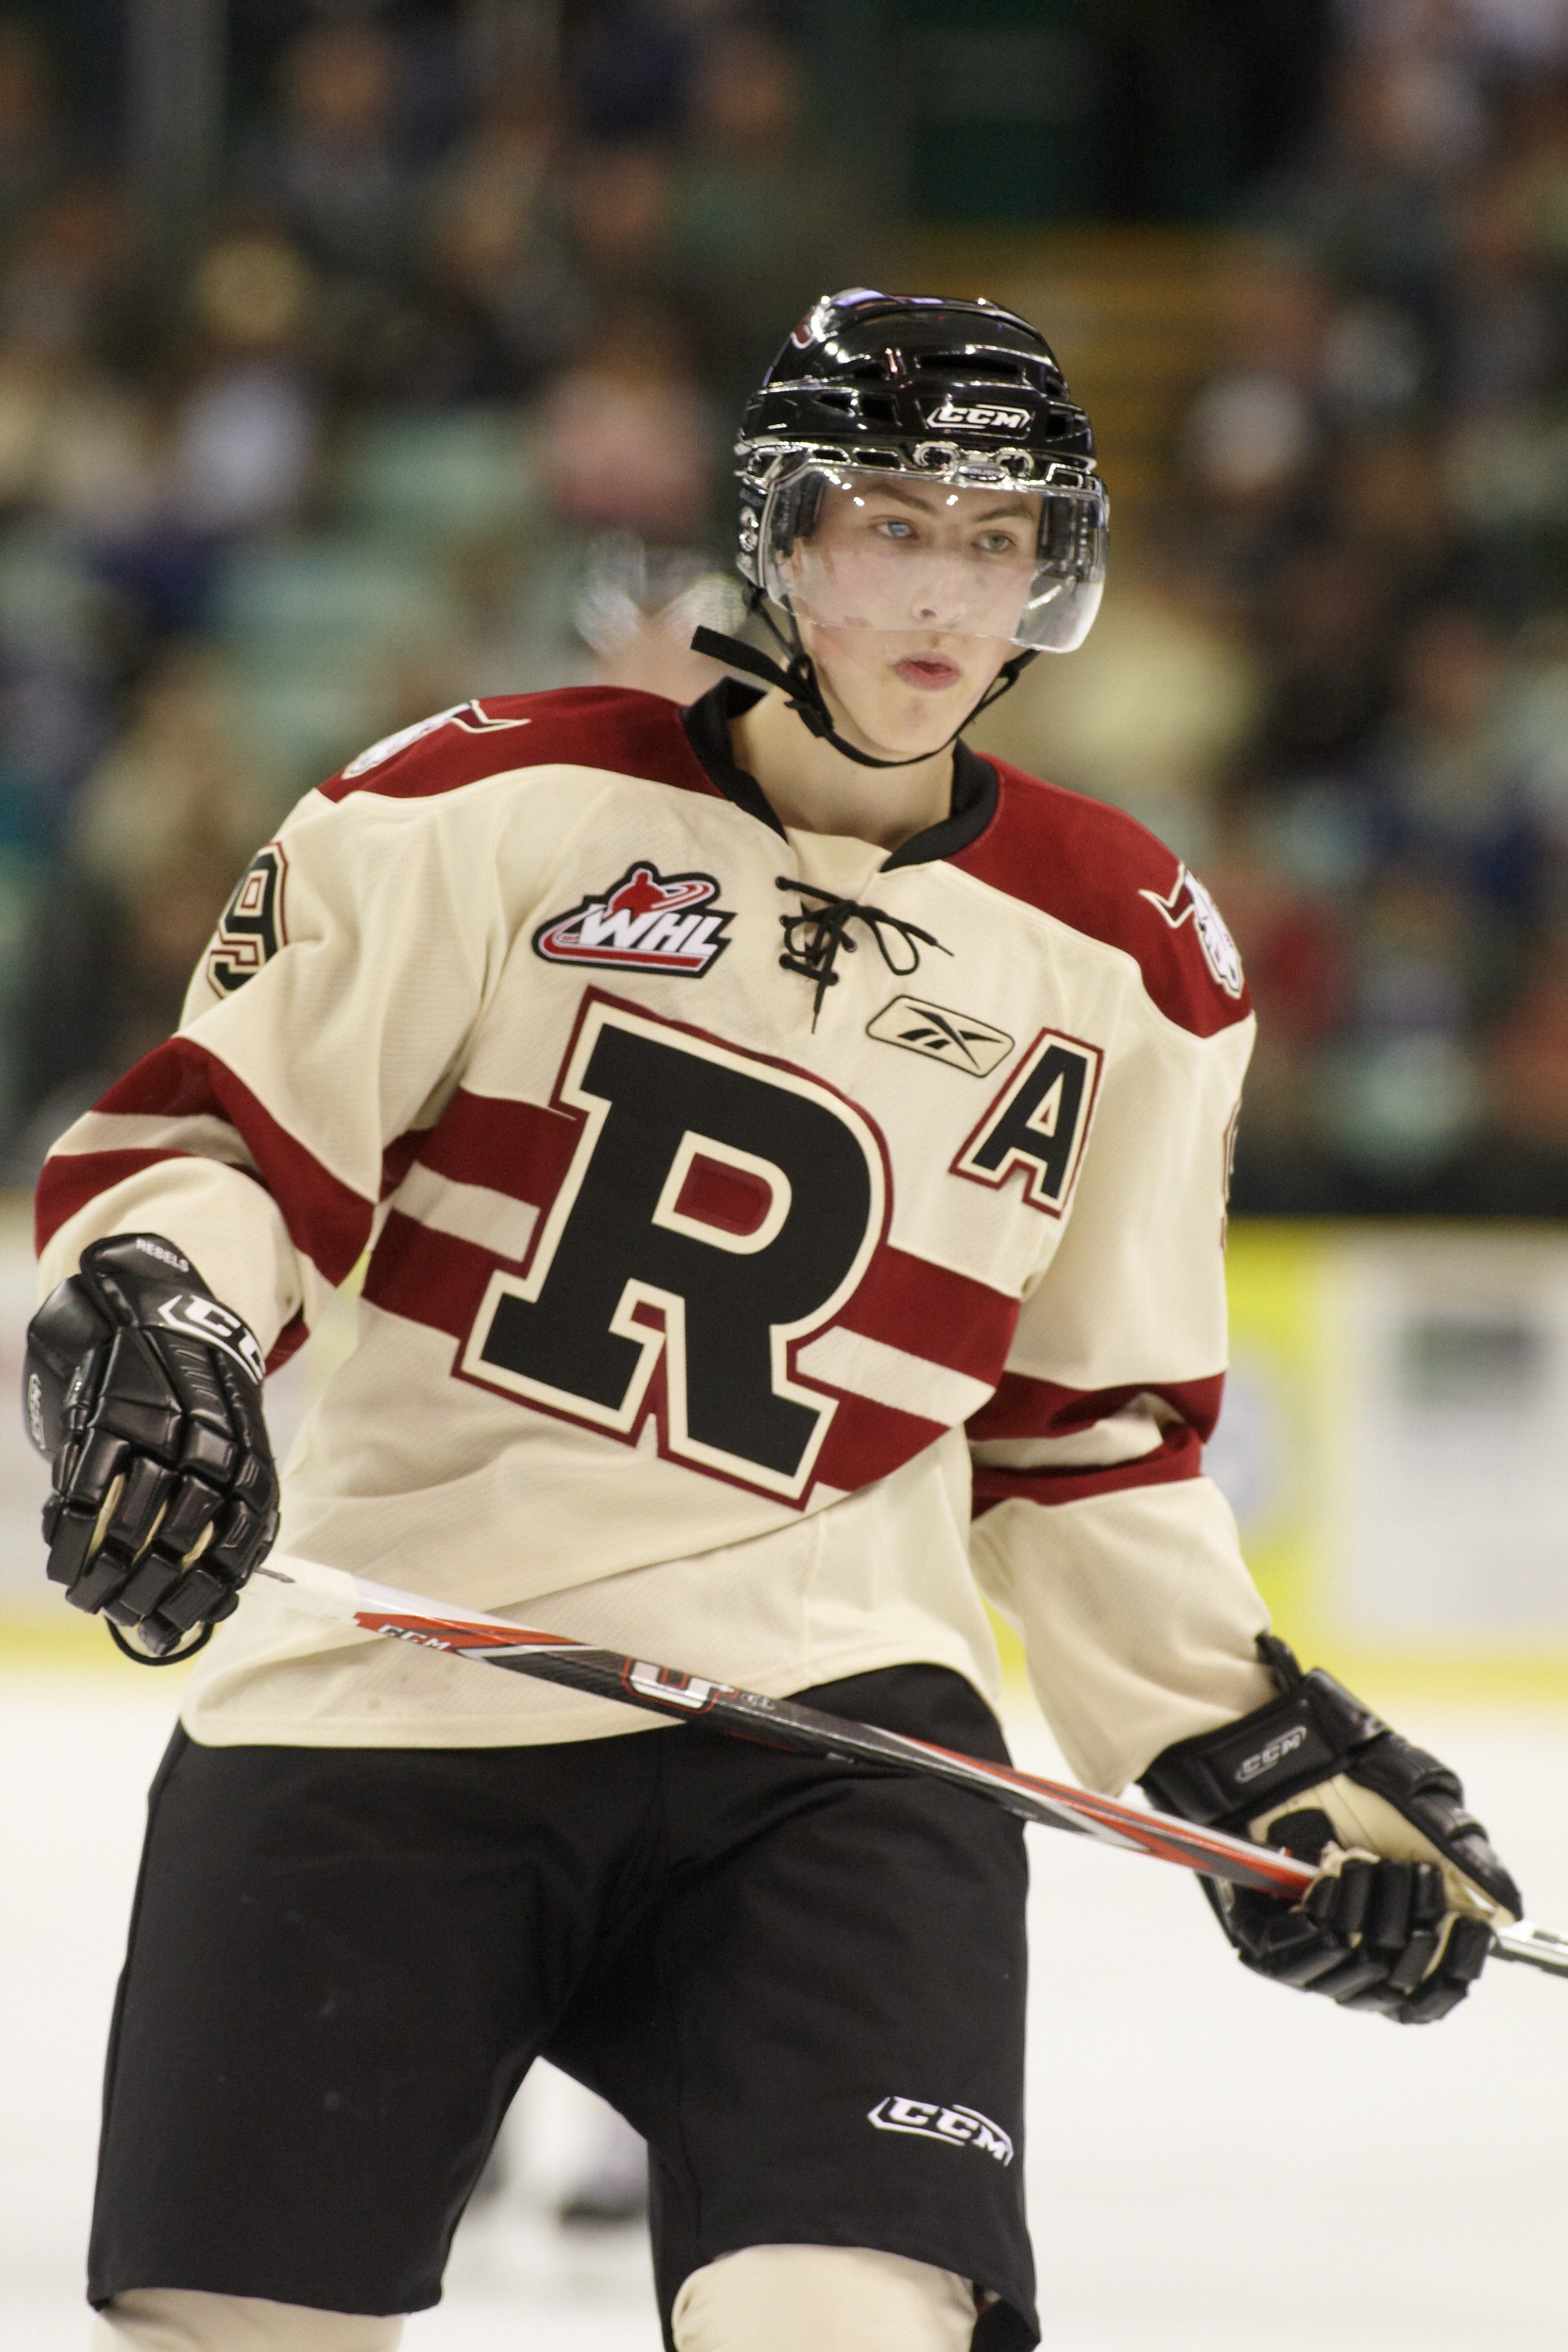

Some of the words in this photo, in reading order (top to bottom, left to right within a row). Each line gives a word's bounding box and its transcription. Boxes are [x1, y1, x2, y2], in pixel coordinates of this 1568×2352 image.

[938, 407, 1022, 428] CCM
[577, 904, 724, 956] WHL
[949, 1028, 1103, 1219] A
[136, 1238, 190, 1273] REBELS
[453, 988, 892, 1511] R
[184, 1294, 267, 1381] CC
[378, 1624, 452, 1651] CCM
[1241, 1732, 1302, 1776] CCM
[888, 2096, 1007, 2161] CCM
